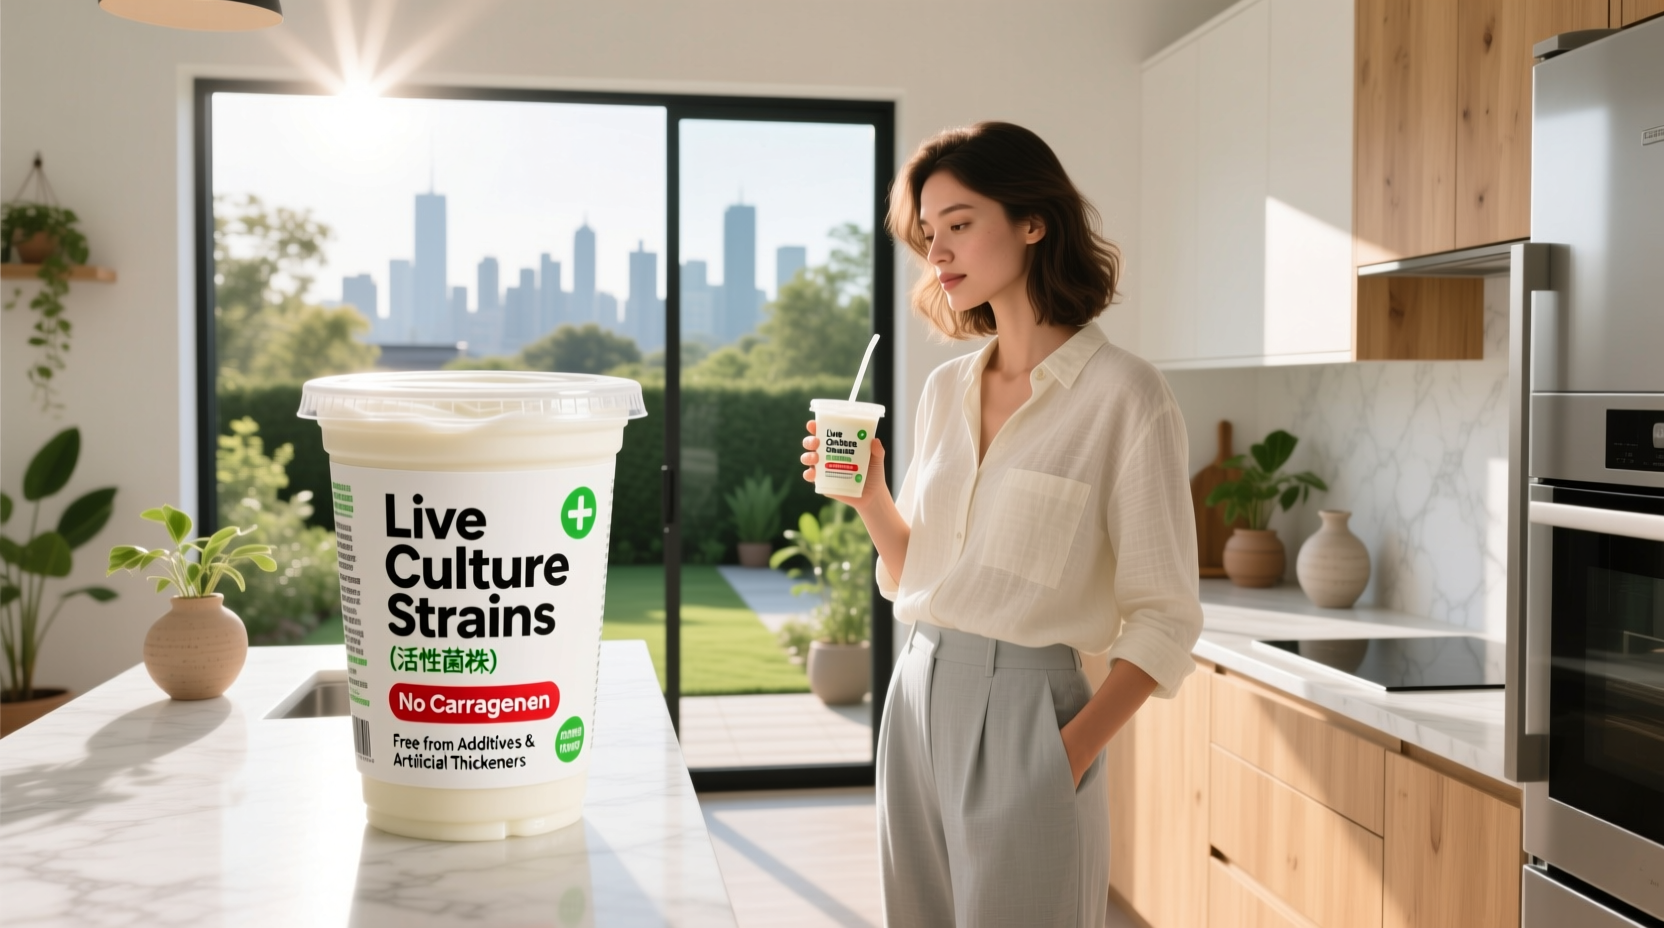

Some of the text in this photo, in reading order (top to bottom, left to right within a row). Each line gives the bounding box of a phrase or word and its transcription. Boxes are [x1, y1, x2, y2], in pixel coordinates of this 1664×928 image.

[385, 493, 487, 541] Live
[385, 544, 570, 590] Culture
[387, 593, 556, 639] Strains
[390, 645, 498, 675] (活性菌株)
[398, 692, 551, 719] No Carragenen
[393, 733, 420, 750] Free
[423, 735, 454, 752] from
[524, 733, 536, 748] &
[450, 754, 526, 771] Thickeners
